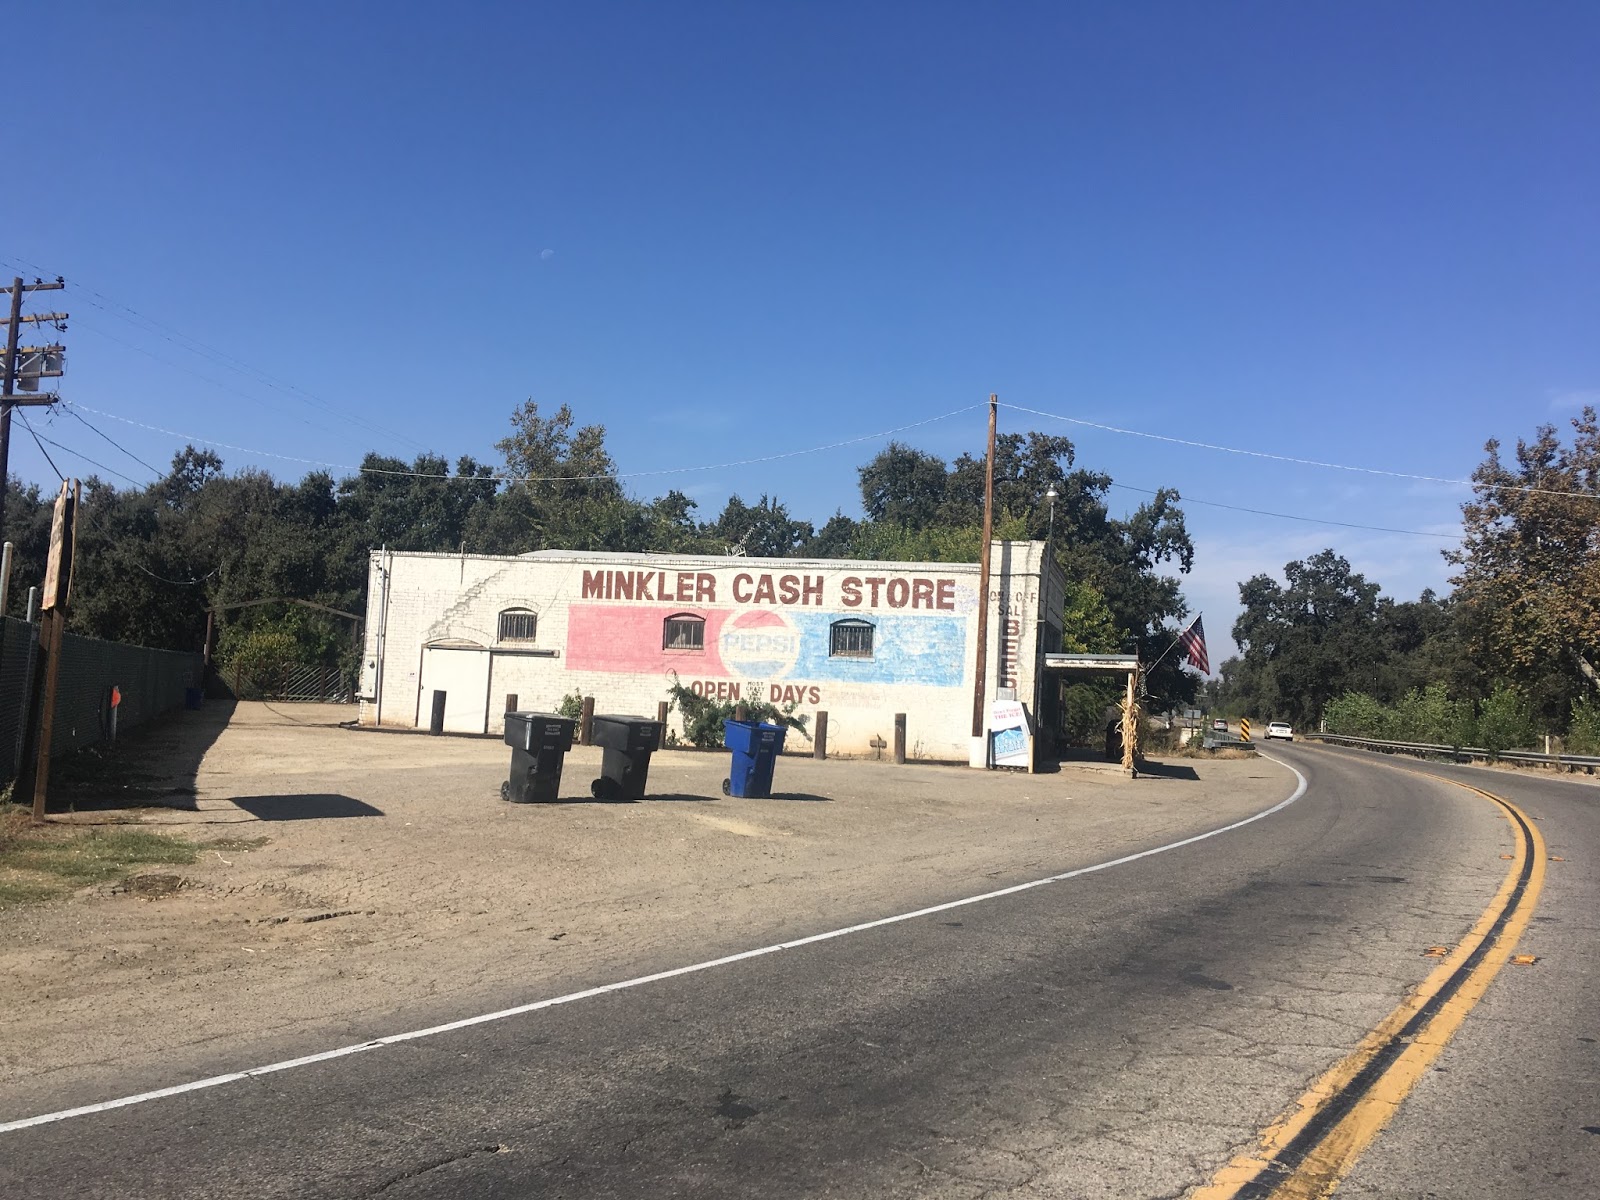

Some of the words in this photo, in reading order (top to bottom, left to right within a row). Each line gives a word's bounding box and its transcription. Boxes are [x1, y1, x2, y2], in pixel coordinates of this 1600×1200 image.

[581, 570, 717, 603] MINKLER
[732, 573, 824, 606] CASH
[841, 576, 956, 610] STORE
[723, 633, 796, 653] PEPSI
[691, 680, 741, 701] OPEN
[769, 683, 821, 705] DAYS
